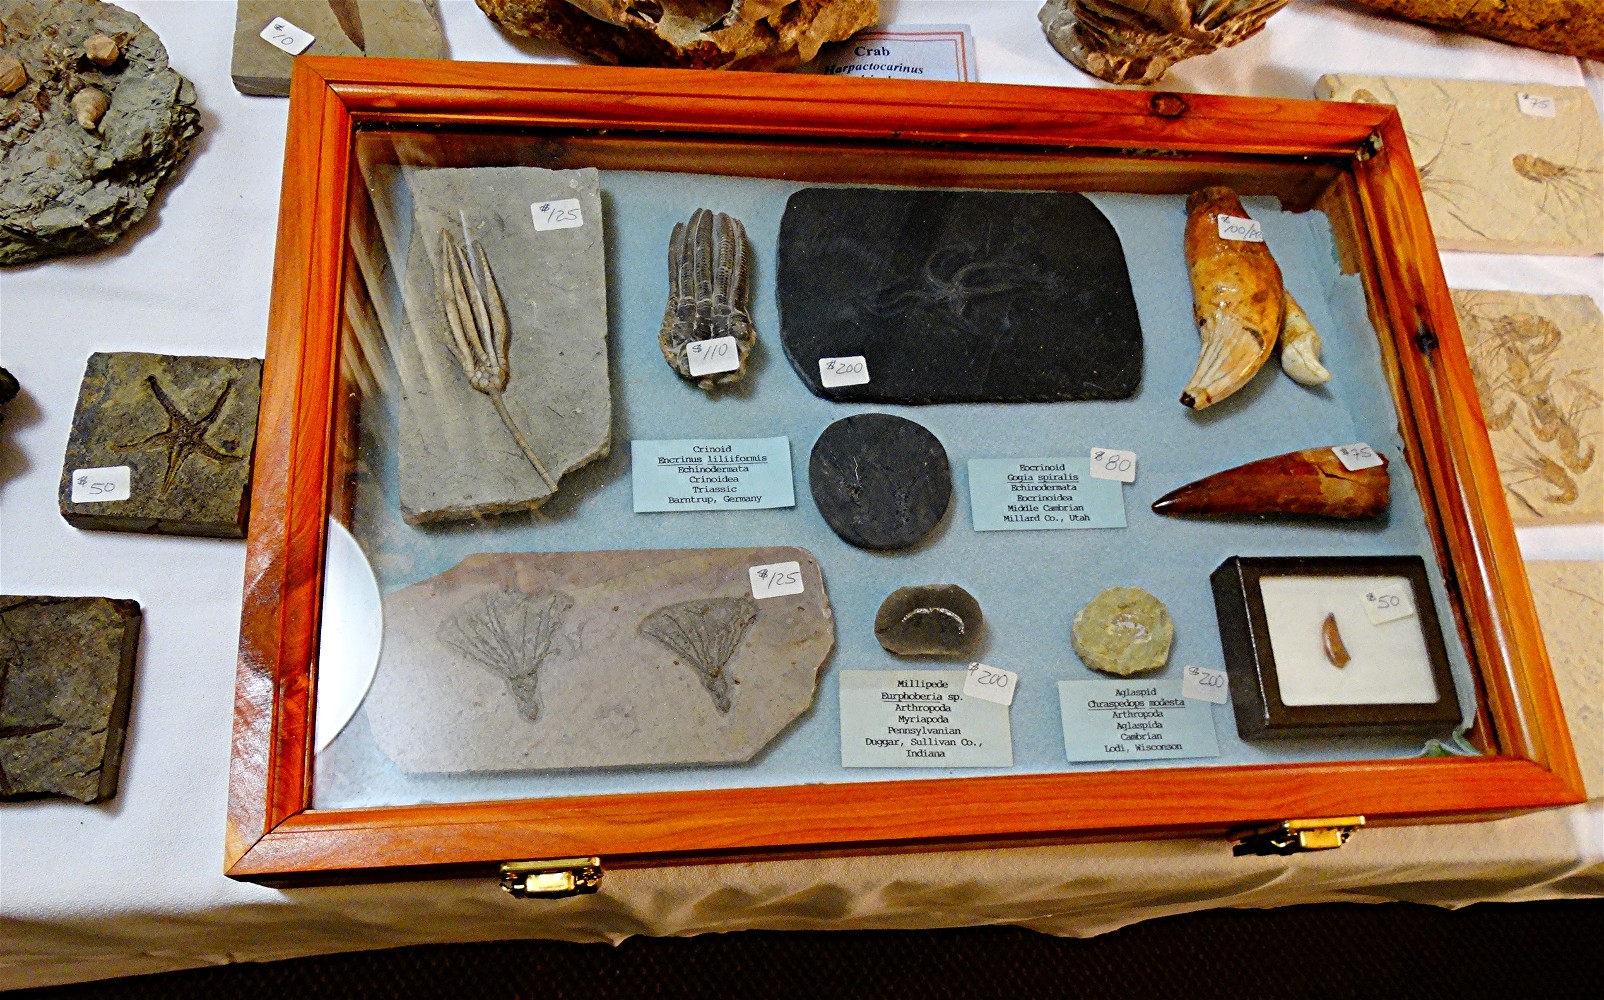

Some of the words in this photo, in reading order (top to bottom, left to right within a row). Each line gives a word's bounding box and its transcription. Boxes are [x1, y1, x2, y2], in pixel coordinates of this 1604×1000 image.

[854, 46, 890, 57] Crab
[823, 63, 923, 75] Harpactocarinus
[539, 203, 580, 223] $125
[691, 343, 728, 361] $110
[826, 360, 863, 375] $200
[692, 445, 732, 453] Crinoid
[1340, 446, 1372, 460] $75
[657, 456, 703, 464] Encrinus
[707, 455, 767, 463] liliiformis
[1094, 451, 1132, 472] $80
[677, 466, 750, 474] Echinodermata
[1019, 463, 1066, 471] Eocrinoid
[1007, 473, 1034, 482] Gogia
[1037, 473, 1079, 482] spiralis
[76, 475, 116, 494] $50
[1011, 483, 1077, 491] Echinodermata
[668, 496, 717, 505] Barntrup,
[723, 495, 762, 504] Germany
[1017, 494, 1073, 502] Eocrinoidea
[1007, 504, 1039, 512] Middle
[1042, 504, 1085, 512] Cambrian
[1003, 514, 1041, 522] Millard
[1044, 514, 1064, 523] Co.,
[1069, 514, 1091, 522] Utah
[757, 568, 801, 589] $125
[1366, 592, 1400, 609] $50
[968, 663, 1009, 688] $200
[1188, 666, 1225, 688] $200
[897, 679, 949, 689] Millipede
[947, 693, 963, 702] sp.
[1115, 687, 1157, 698] Aglaspid
[895, 703, 951, 713] Arthropoda
[898, 715, 949, 724] Myriapoda
[1112, 710, 1164, 719] Arthropoda
[887, 726, 961, 736] Pennsylvanian
[1116, 721, 1164, 731] Aglaspida
[1120, 732, 1163, 741] Cambrian
[865, 737, 904, 747] Duggar,
[910, 738, 957, 746] Sullivan
[960, 738, 983, 747] Co.,
[906, 749, 946, 758] Indiana
[1105, 744, 1130, 753] Lodi,
